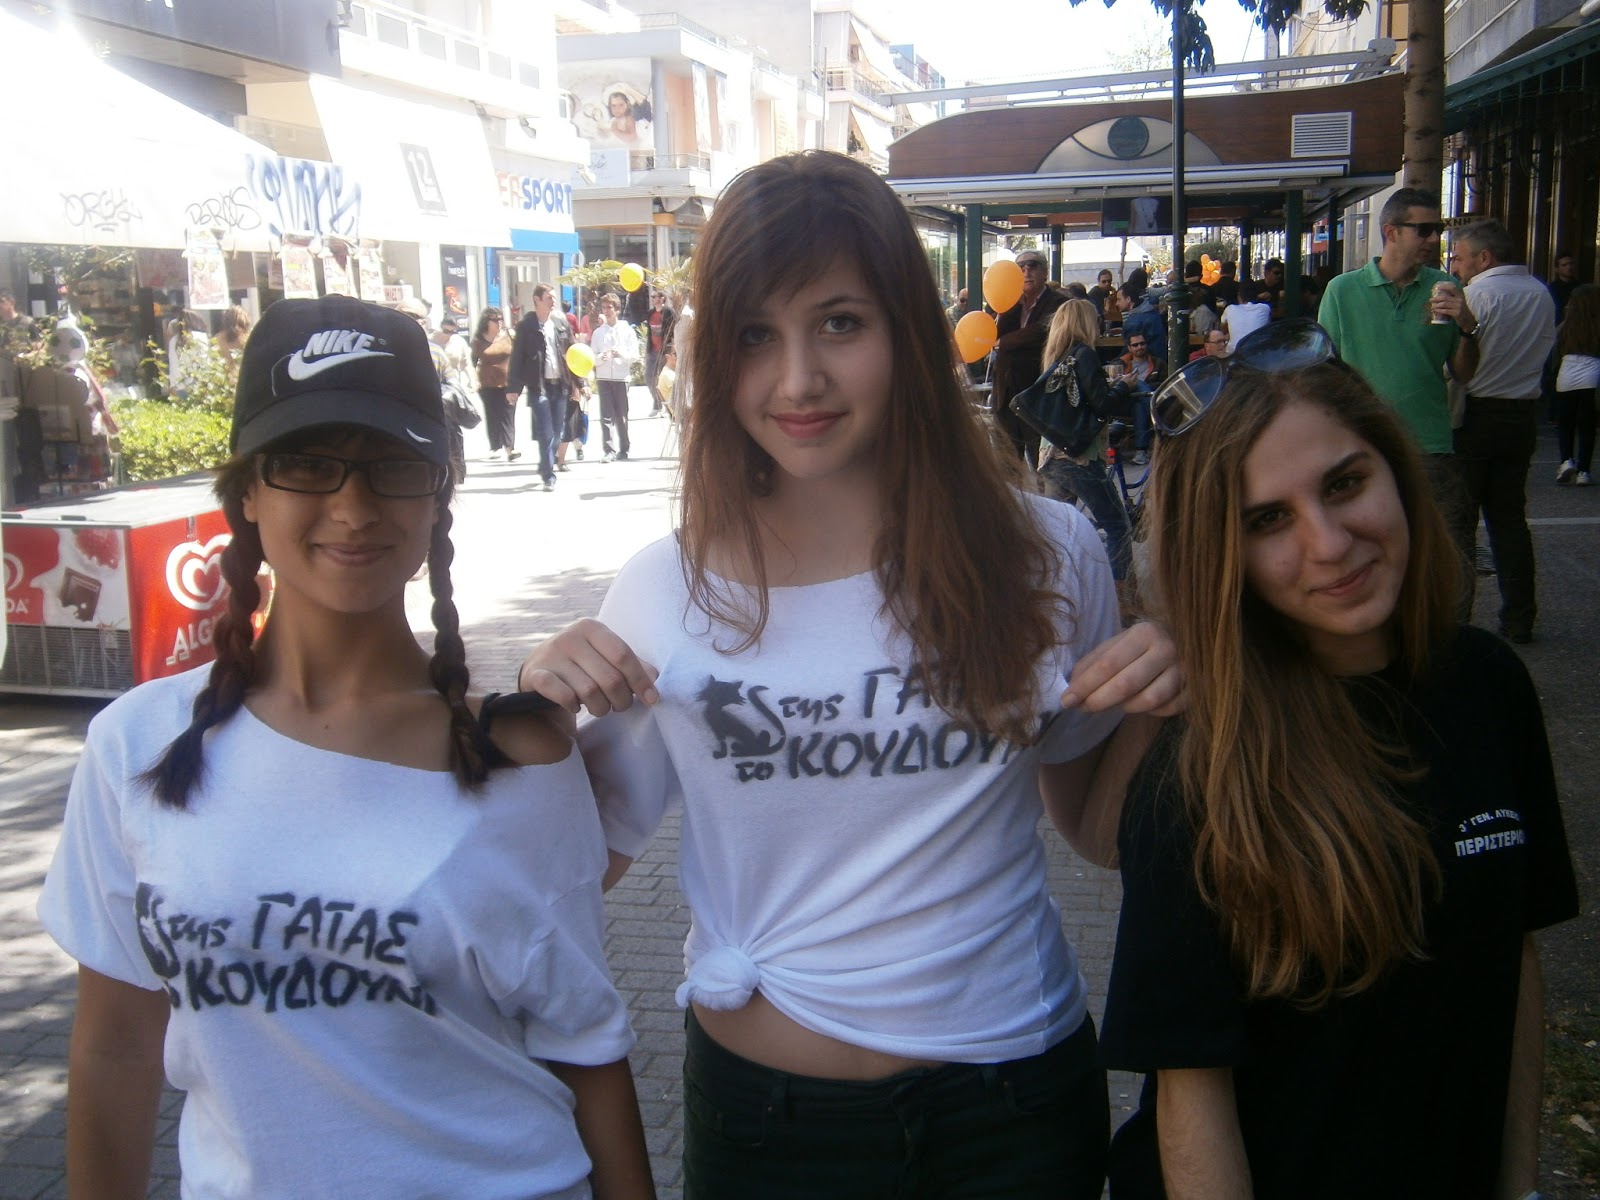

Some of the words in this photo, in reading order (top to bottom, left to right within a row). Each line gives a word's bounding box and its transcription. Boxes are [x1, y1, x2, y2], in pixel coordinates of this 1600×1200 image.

[303, 329, 375, 358] NIKE
[173, 615, 217, 658] ALG
[252, 892, 419, 965] ΓΑΤΑΣ
